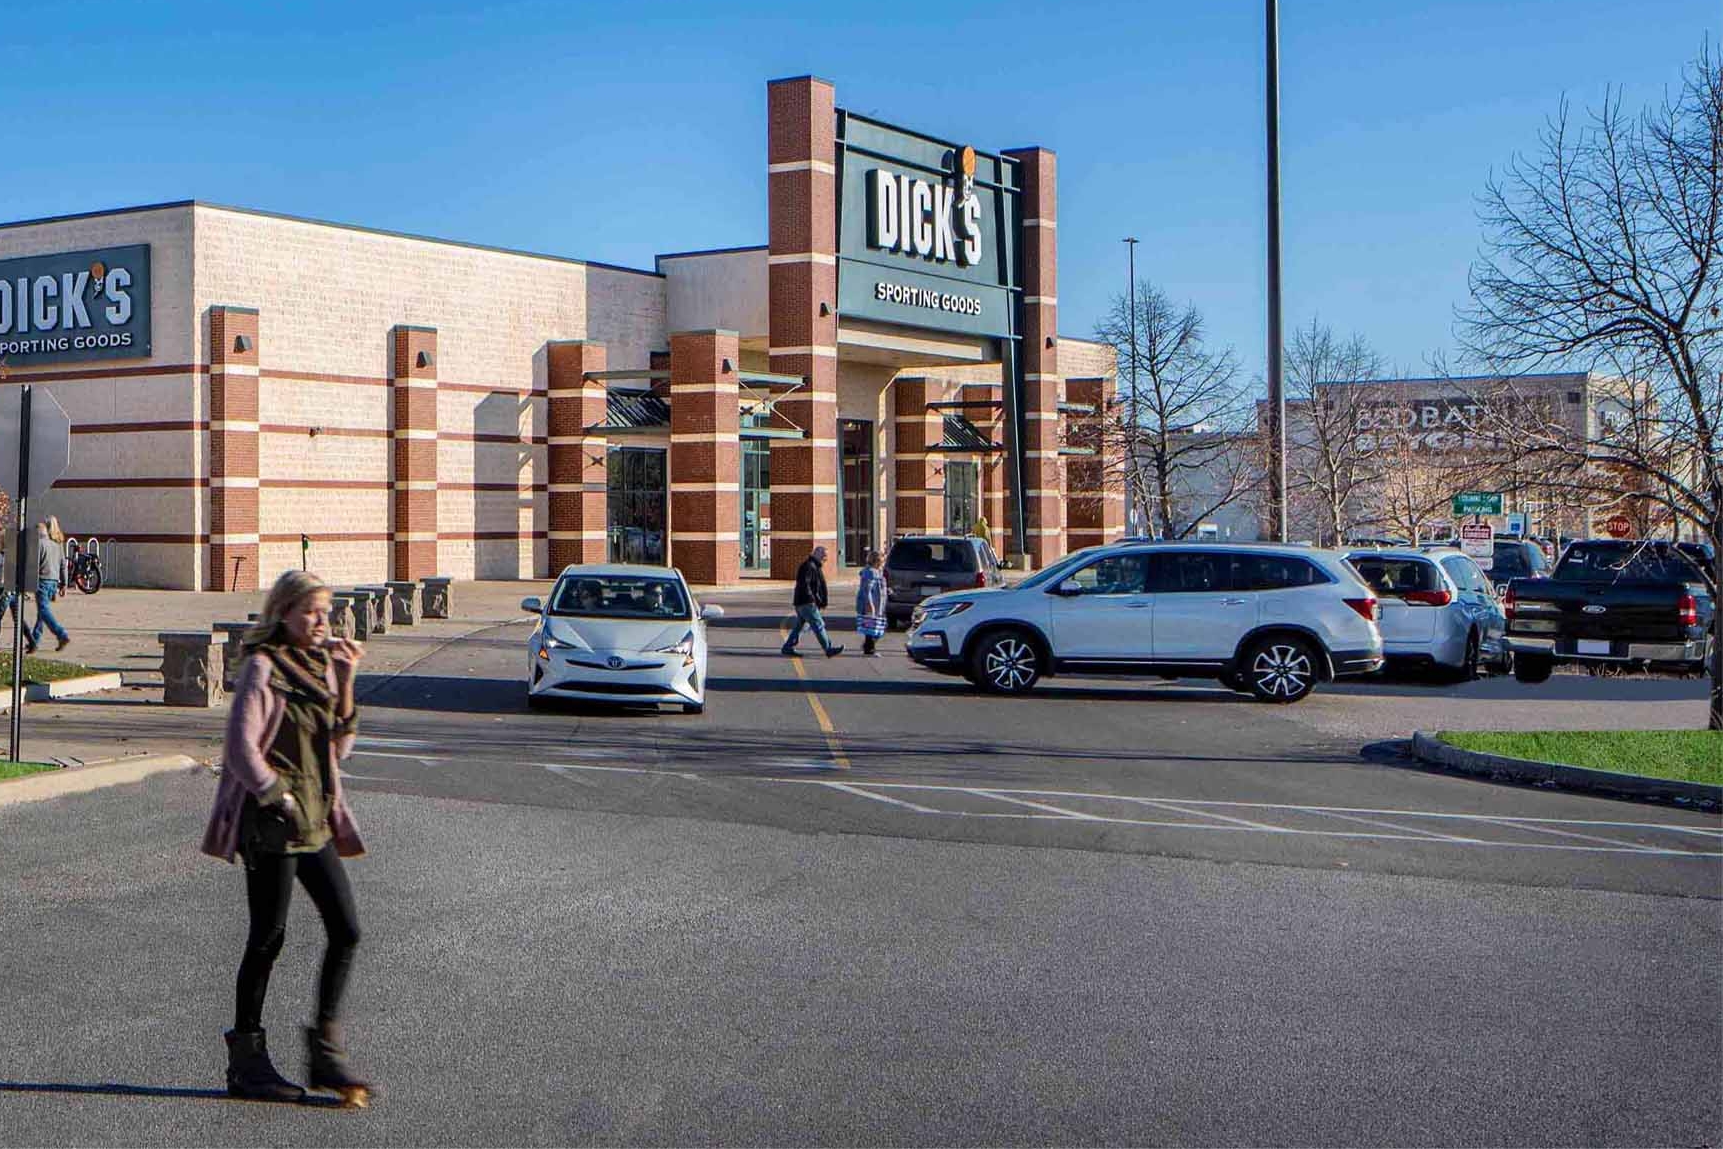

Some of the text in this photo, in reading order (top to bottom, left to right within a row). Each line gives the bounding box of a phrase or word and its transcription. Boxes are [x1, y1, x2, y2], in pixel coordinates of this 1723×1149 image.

[876, 147, 982, 266] DICK'S
[877, 282, 981, 315] SPORTING GOODS
[74, 333, 131, 349] GOODS
[1607, 521, 1629, 531] STOP
